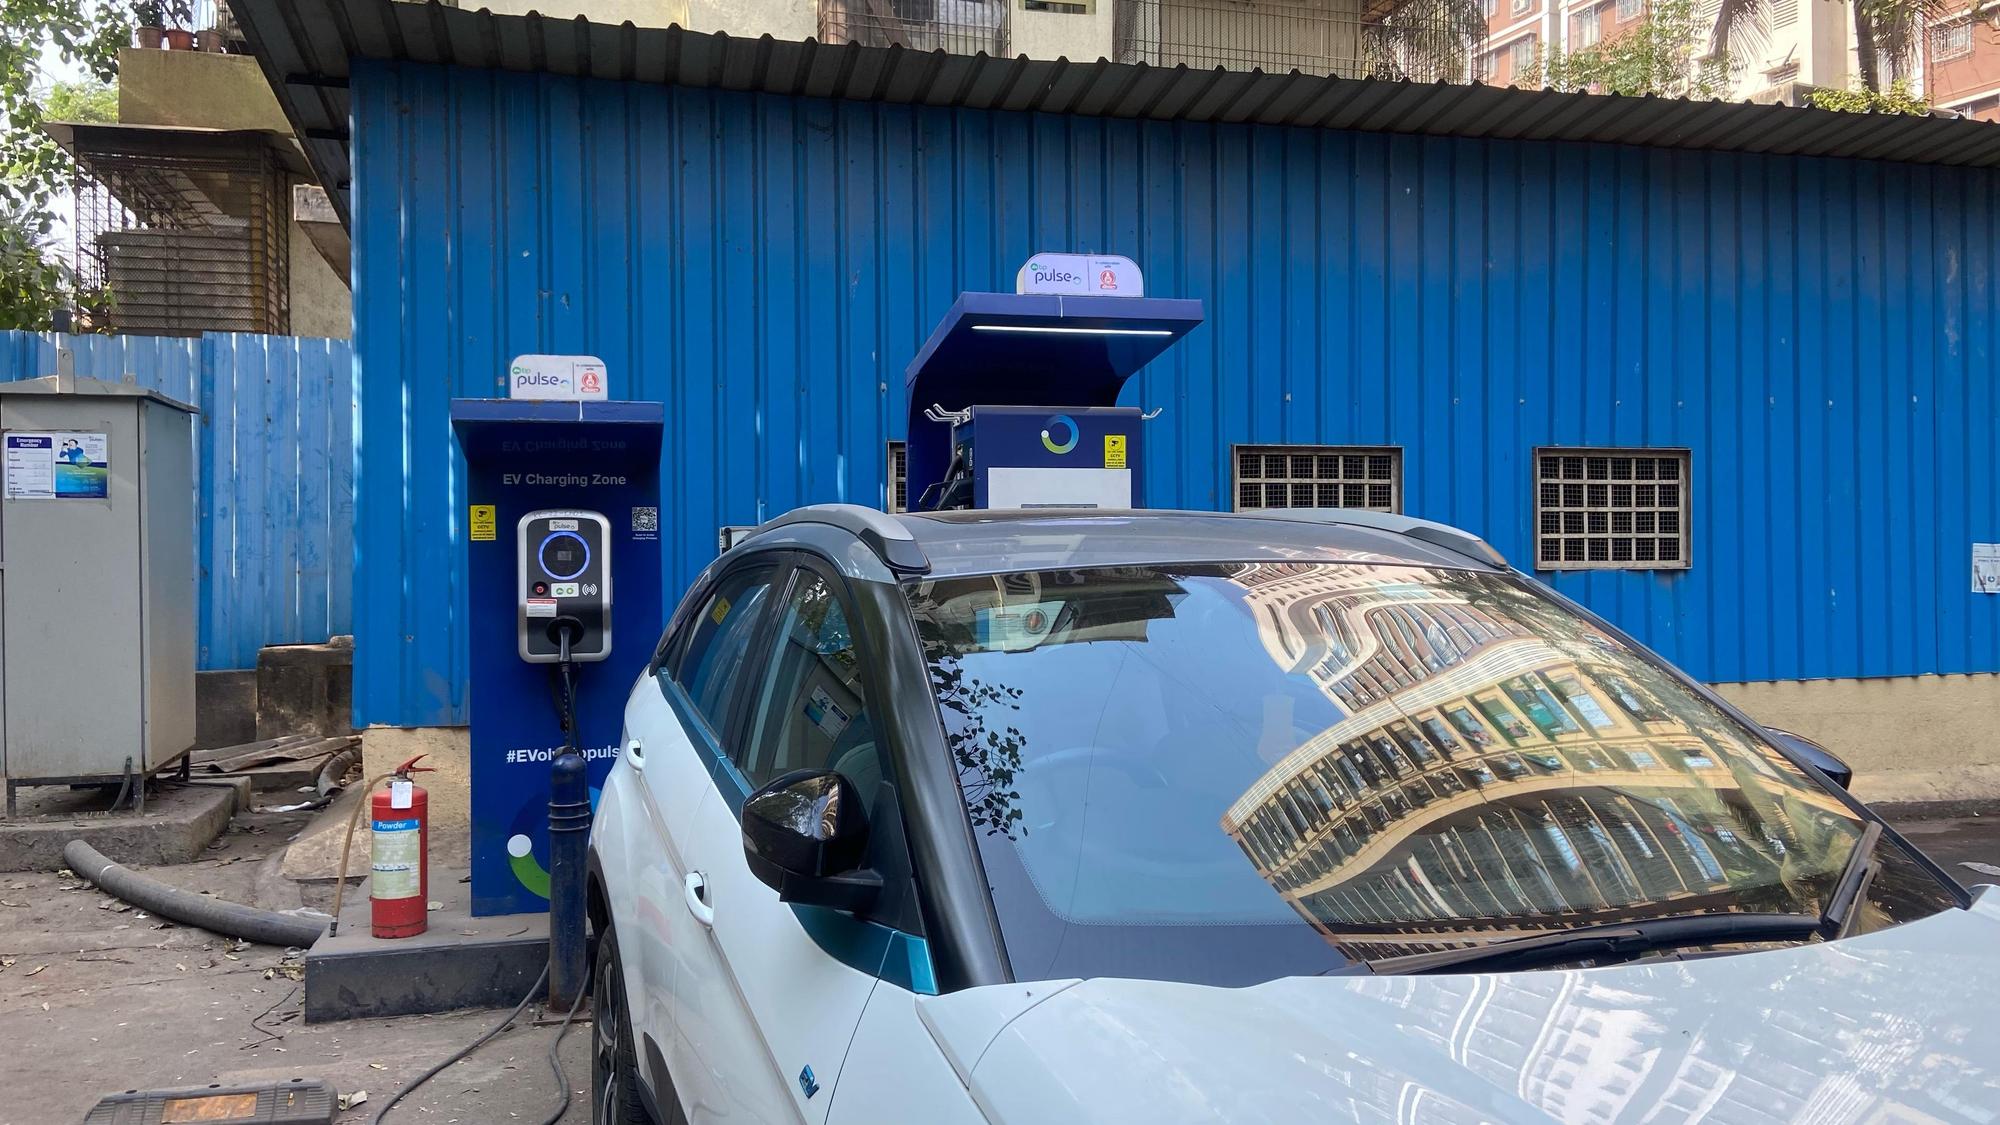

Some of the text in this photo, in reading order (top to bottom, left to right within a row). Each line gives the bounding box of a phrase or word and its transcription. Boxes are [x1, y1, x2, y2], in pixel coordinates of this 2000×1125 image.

[1035, 268, 1072, 285] pulse
[517, 372, 559, 388] pulse
[503, 473, 626, 487] EV Charging Zone
[378, 821, 407, 830] Powder
